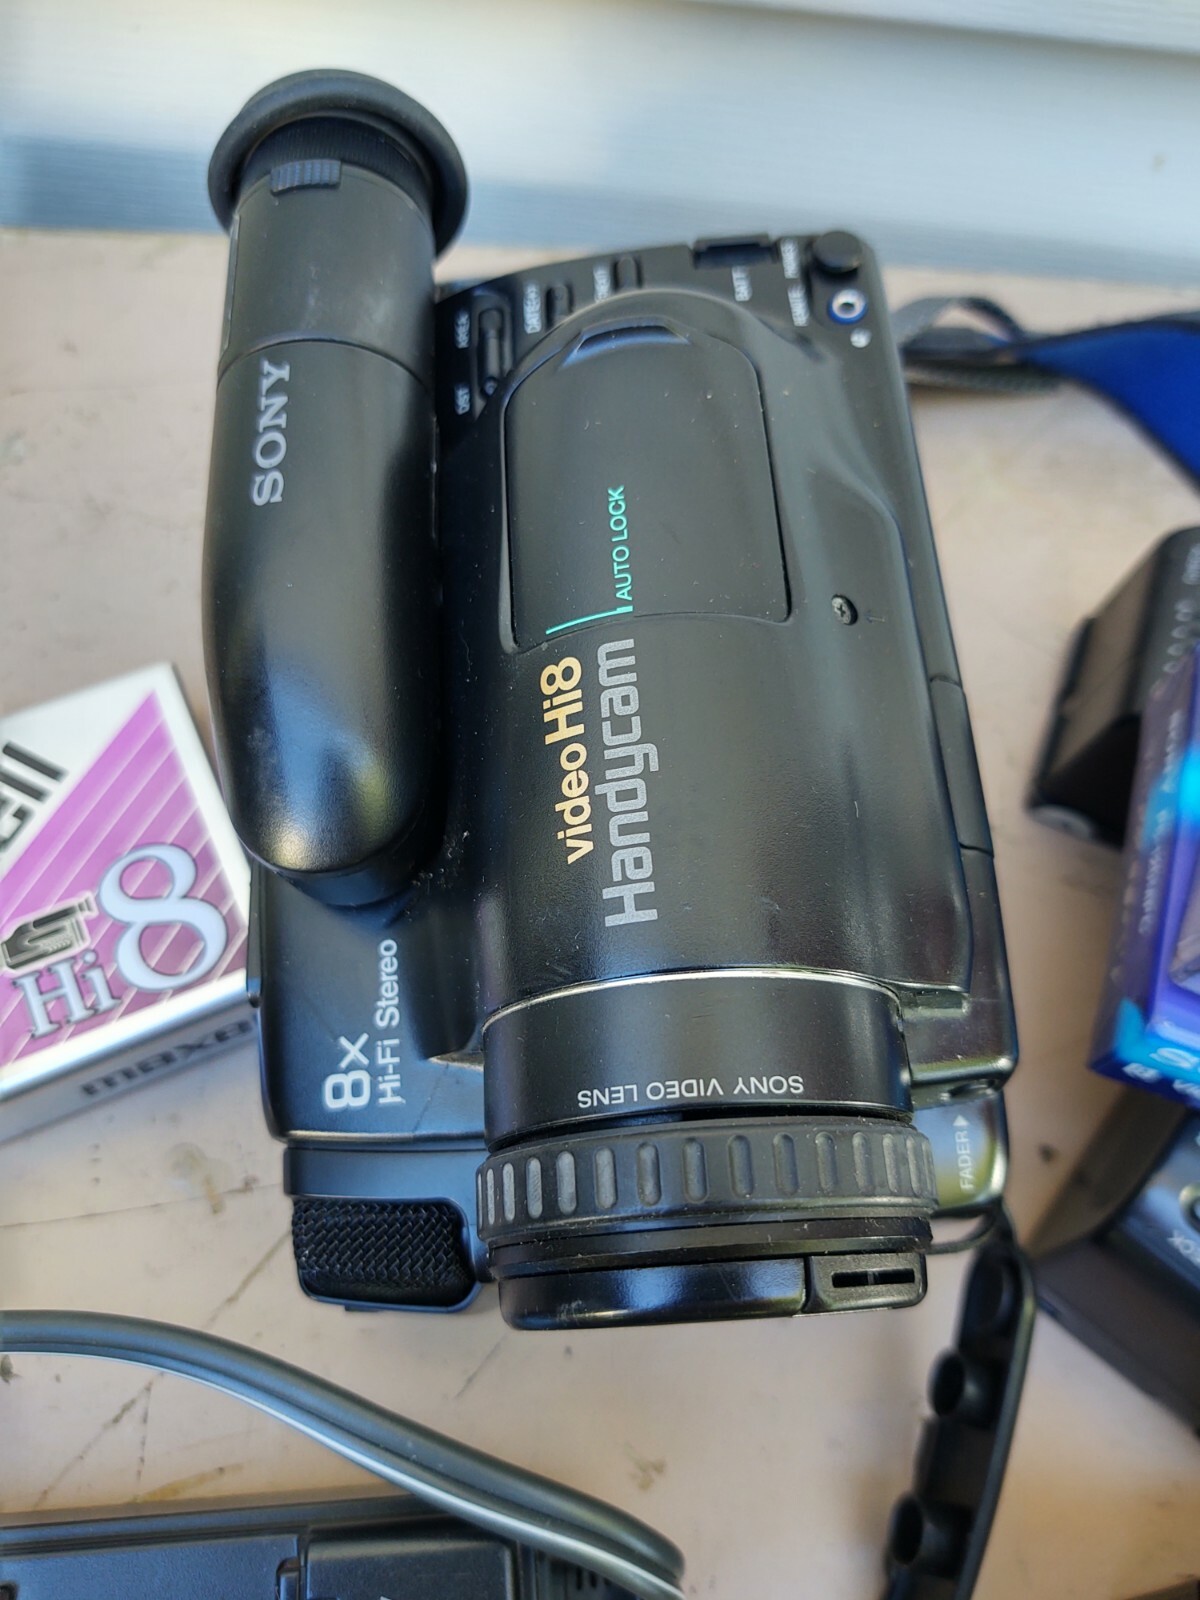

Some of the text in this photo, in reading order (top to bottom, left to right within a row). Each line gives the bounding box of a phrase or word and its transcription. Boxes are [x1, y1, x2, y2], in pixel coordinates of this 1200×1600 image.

[253, 359, 290, 506] SONY
[608, 485, 632, 600] AUTO LOCK
[597, 638, 659, 927] Handycam
[12, 843, 228, 1039] Hi8
[375, 939, 402, 1103] Hi-Fi Stereo
[577, 1075, 804, 1108] SONY VIDEO LENS
[954, 1130, 975, 1190] FADER
